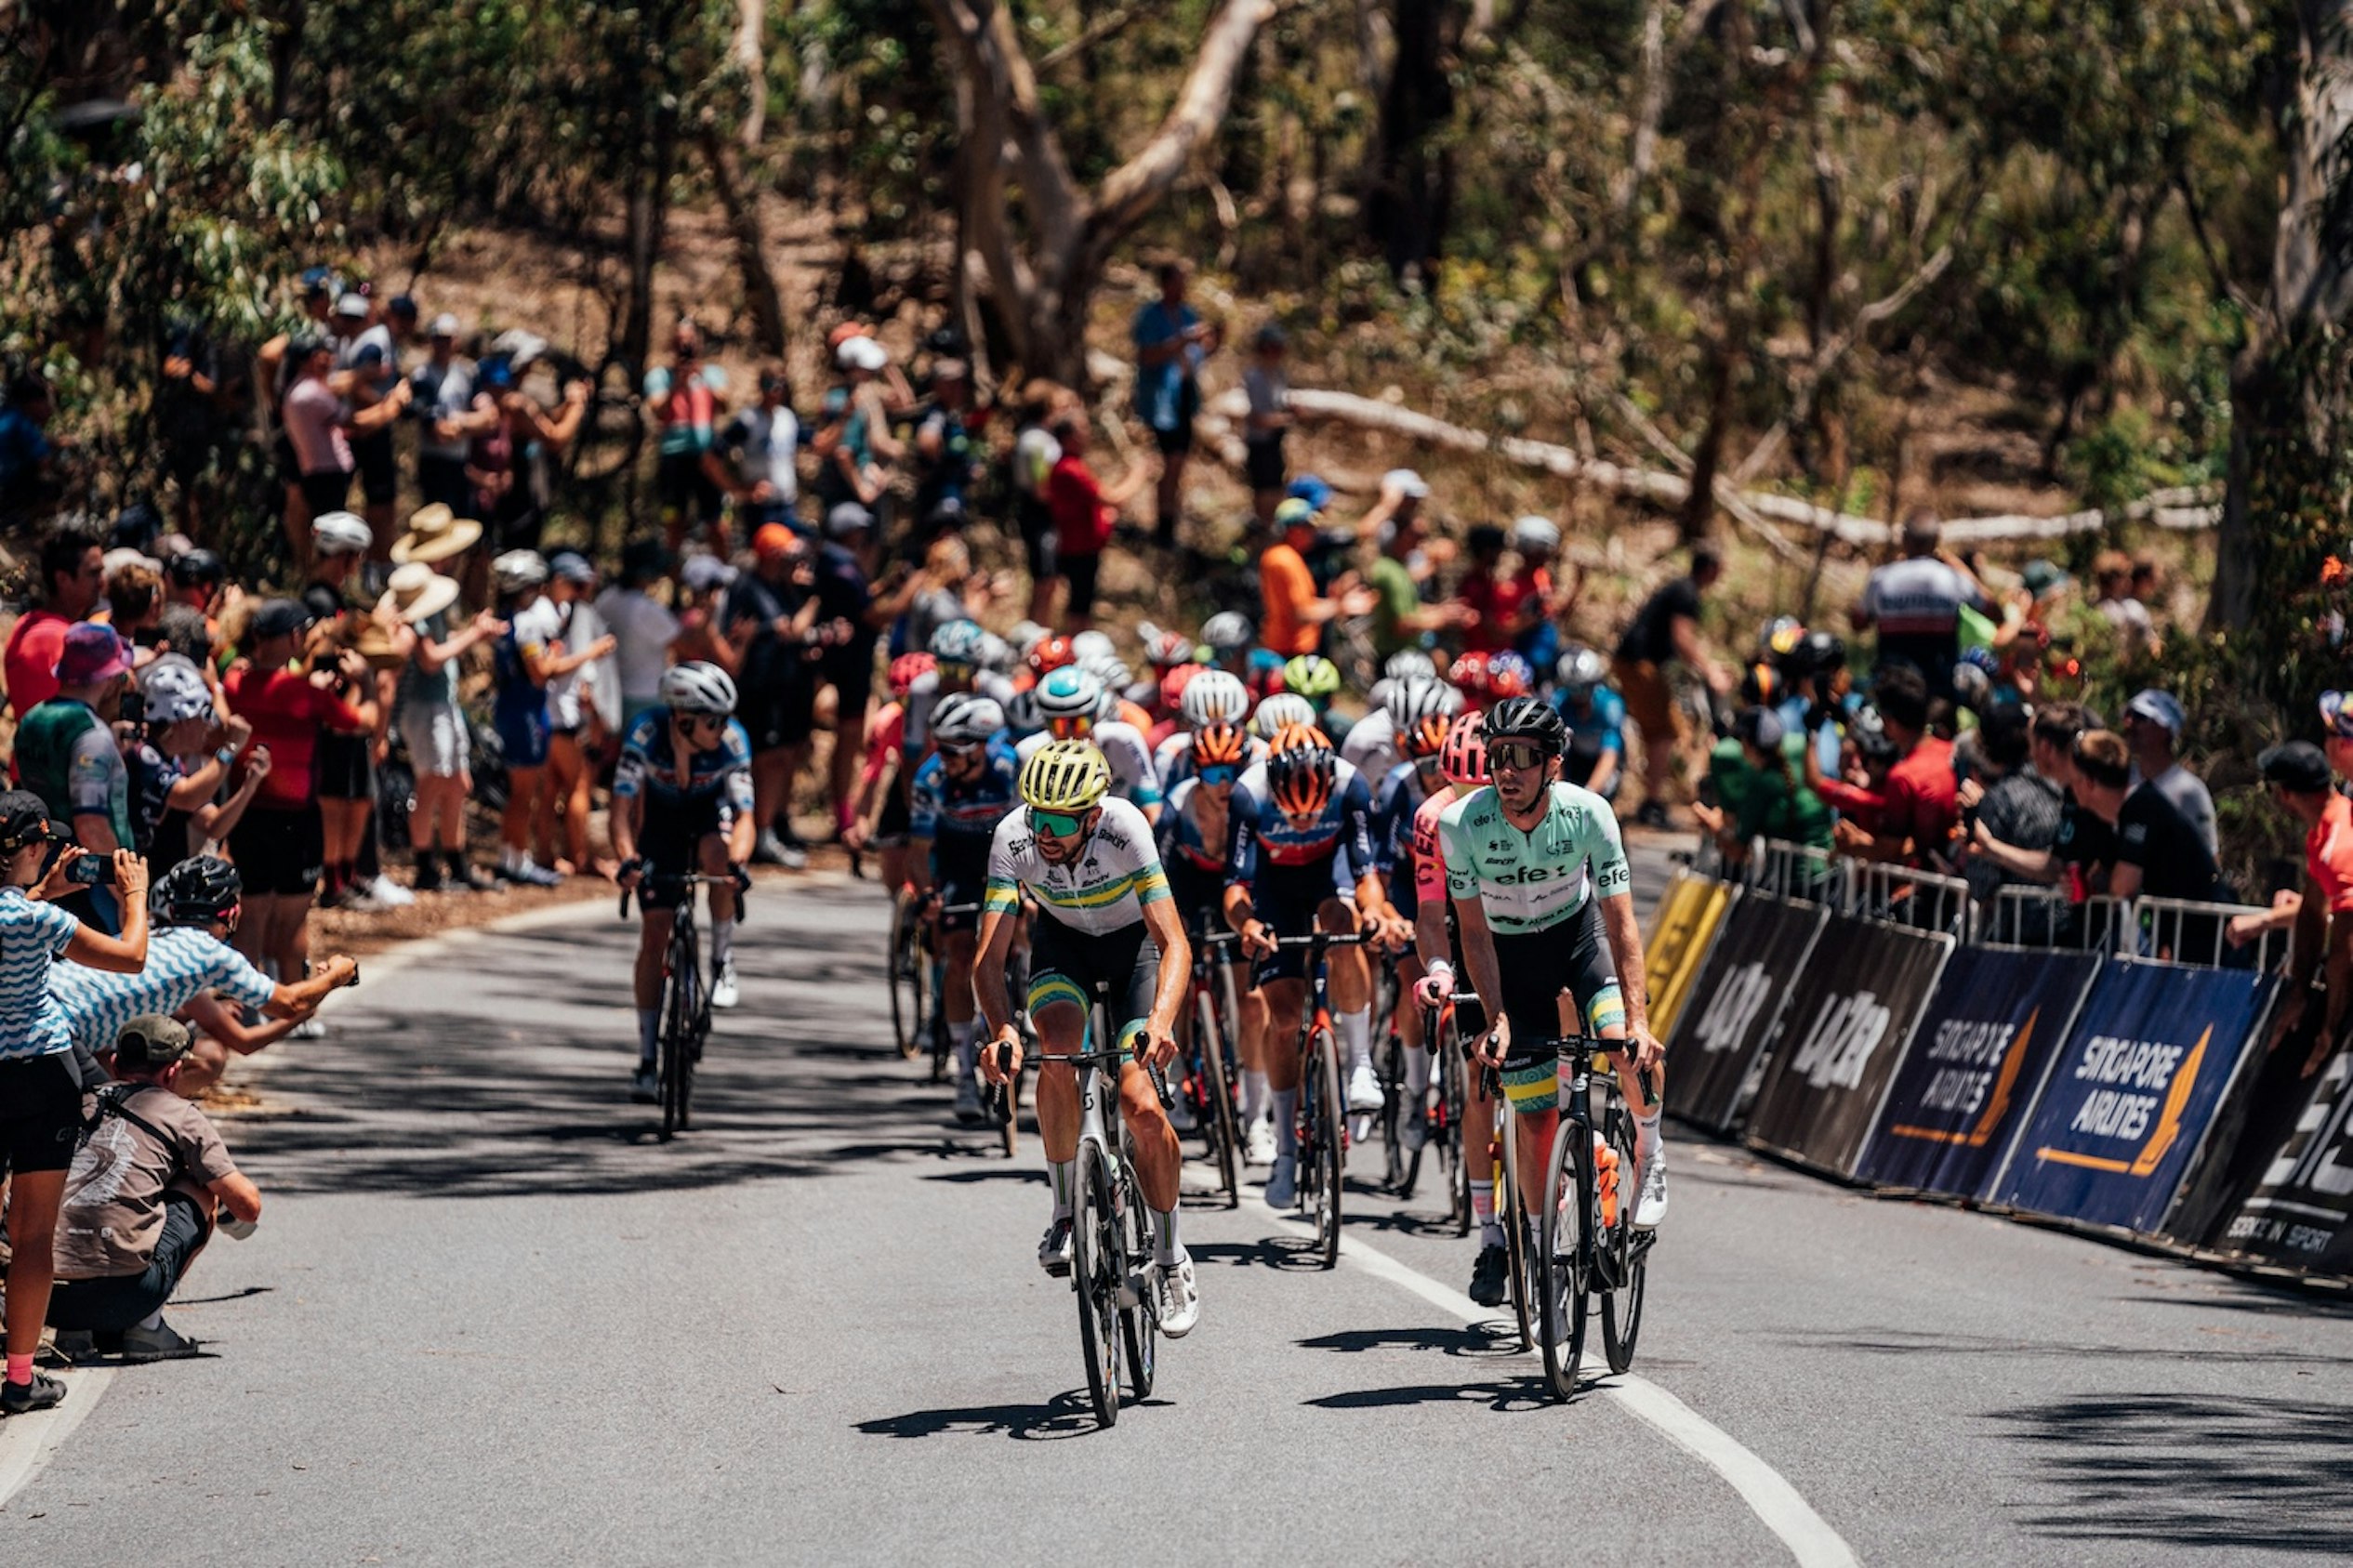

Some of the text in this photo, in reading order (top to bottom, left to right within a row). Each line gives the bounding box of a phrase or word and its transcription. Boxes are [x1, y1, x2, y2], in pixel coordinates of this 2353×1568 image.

[1791, 990, 1891, 1090] LAZER
[2075, 1034, 2184, 1090] SINGAPORE
[2069, 1087, 2159, 1140] AIRLINES
[2285, 1223, 2334, 1254] SPORT
